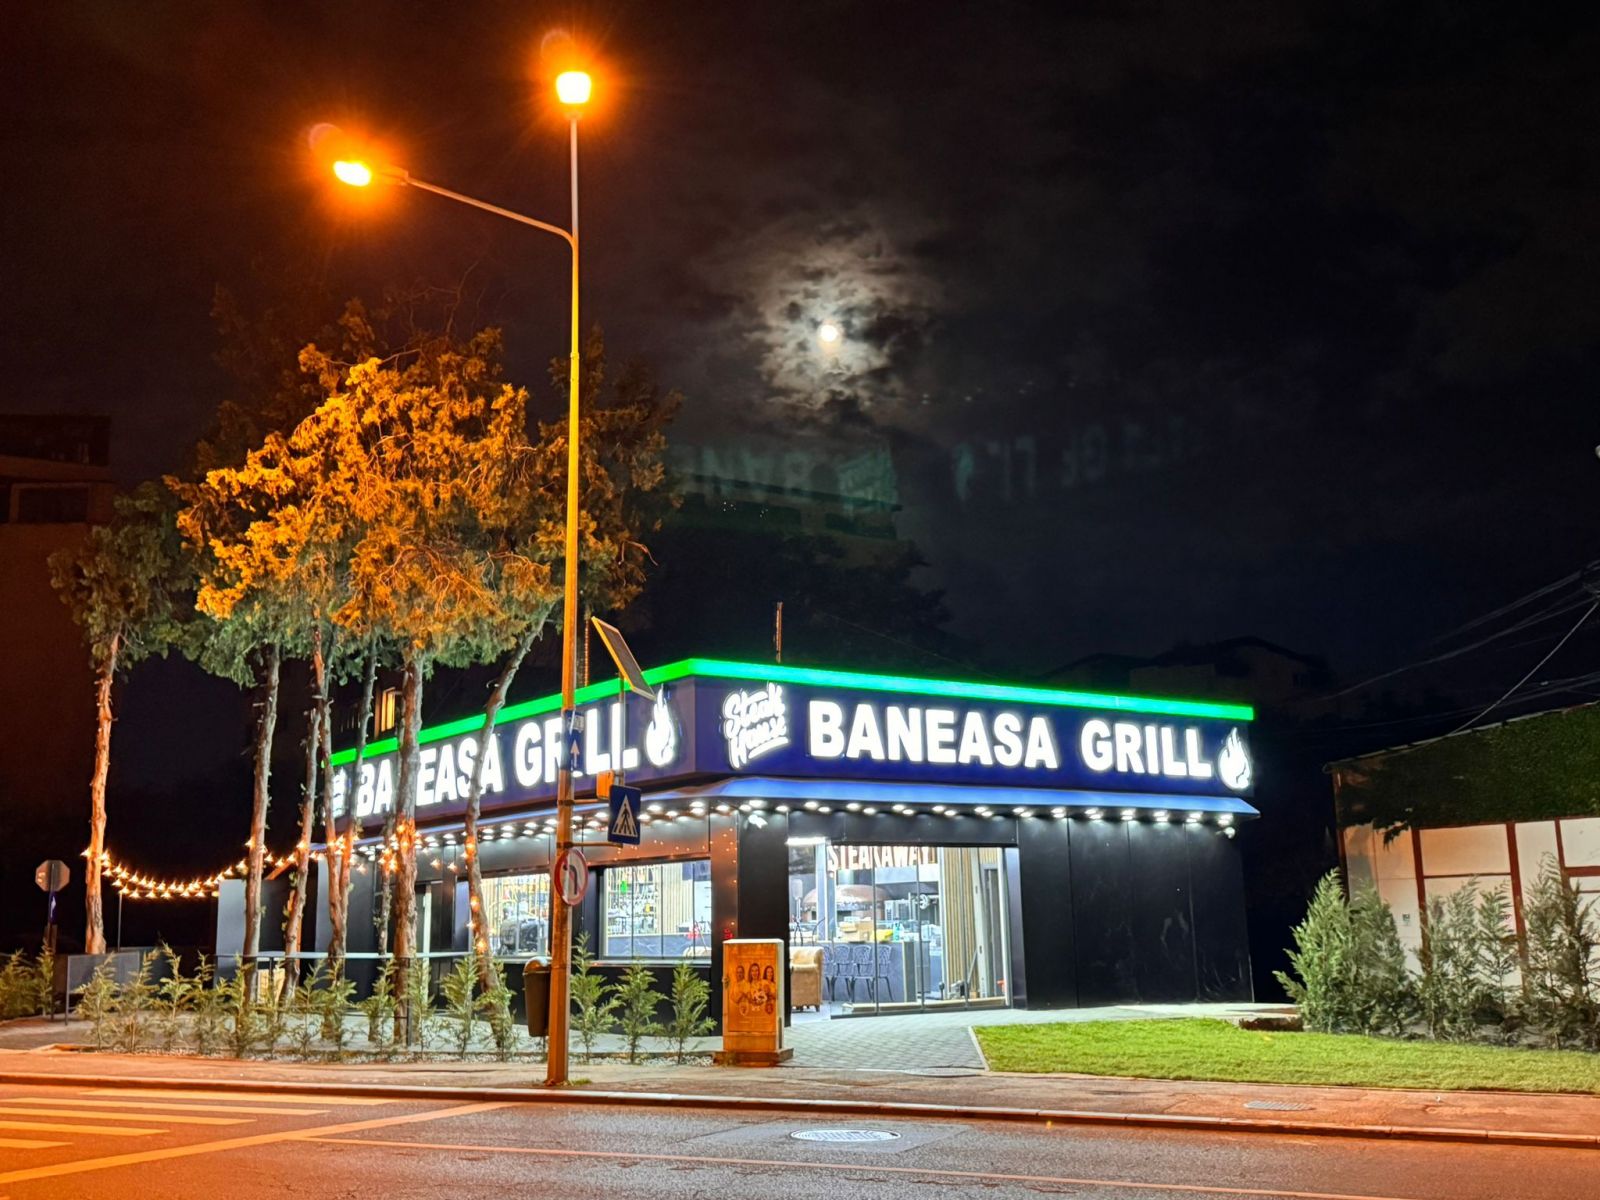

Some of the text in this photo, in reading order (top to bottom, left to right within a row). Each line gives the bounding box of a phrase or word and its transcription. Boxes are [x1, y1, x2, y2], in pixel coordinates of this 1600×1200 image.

[356, 733, 503, 817] BAEASA
[515, 702, 638, 787] GRLL
[808, 700, 1212, 778] BANEASA GRILL
